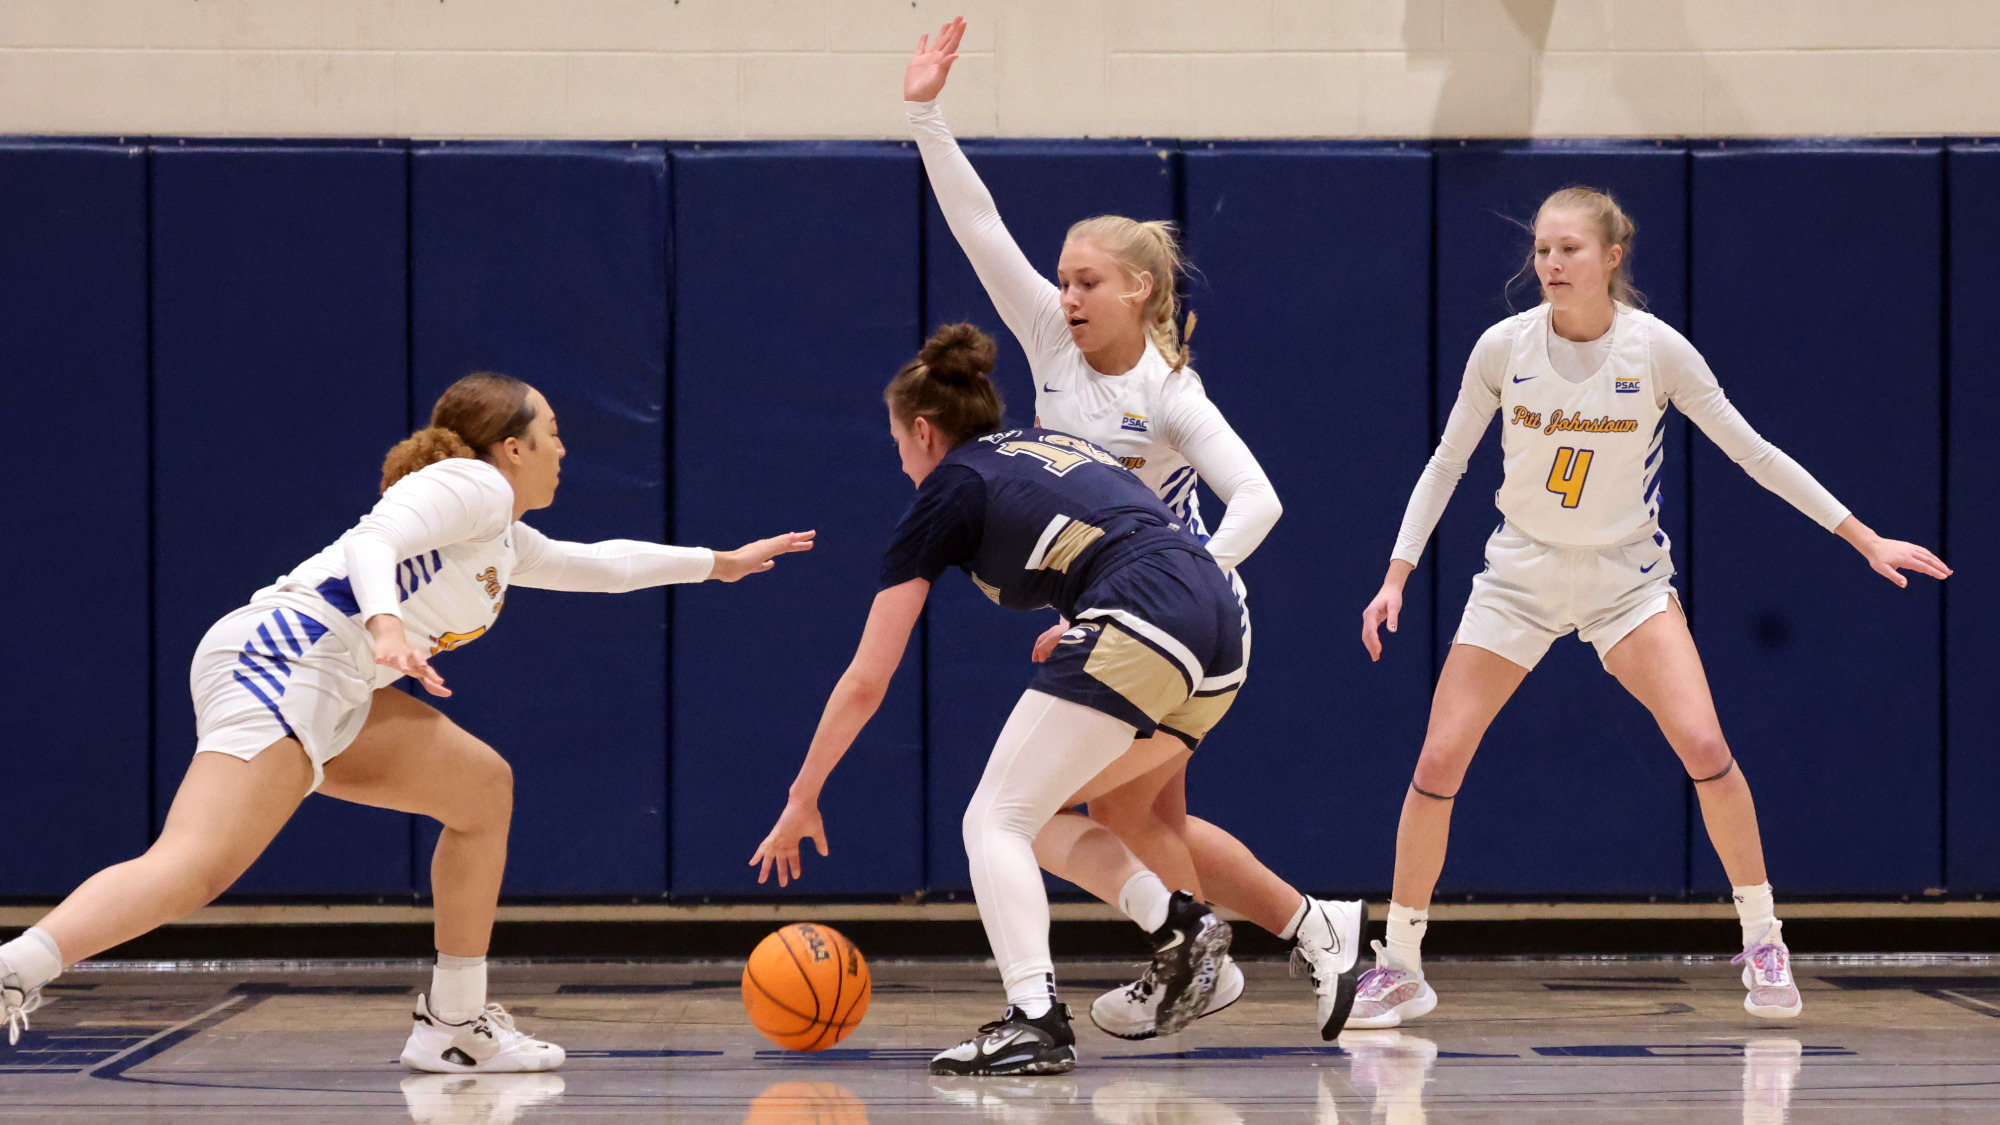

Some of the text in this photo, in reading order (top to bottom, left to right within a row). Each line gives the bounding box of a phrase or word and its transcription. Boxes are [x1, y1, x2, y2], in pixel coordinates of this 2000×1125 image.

[1615, 381, 1640, 389] PSAC
[1122, 416, 1148, 429] PSAC
[1511, 405, 1638, 435] Pitt Johnstown
[1546, 446, 1594, 508] 4
